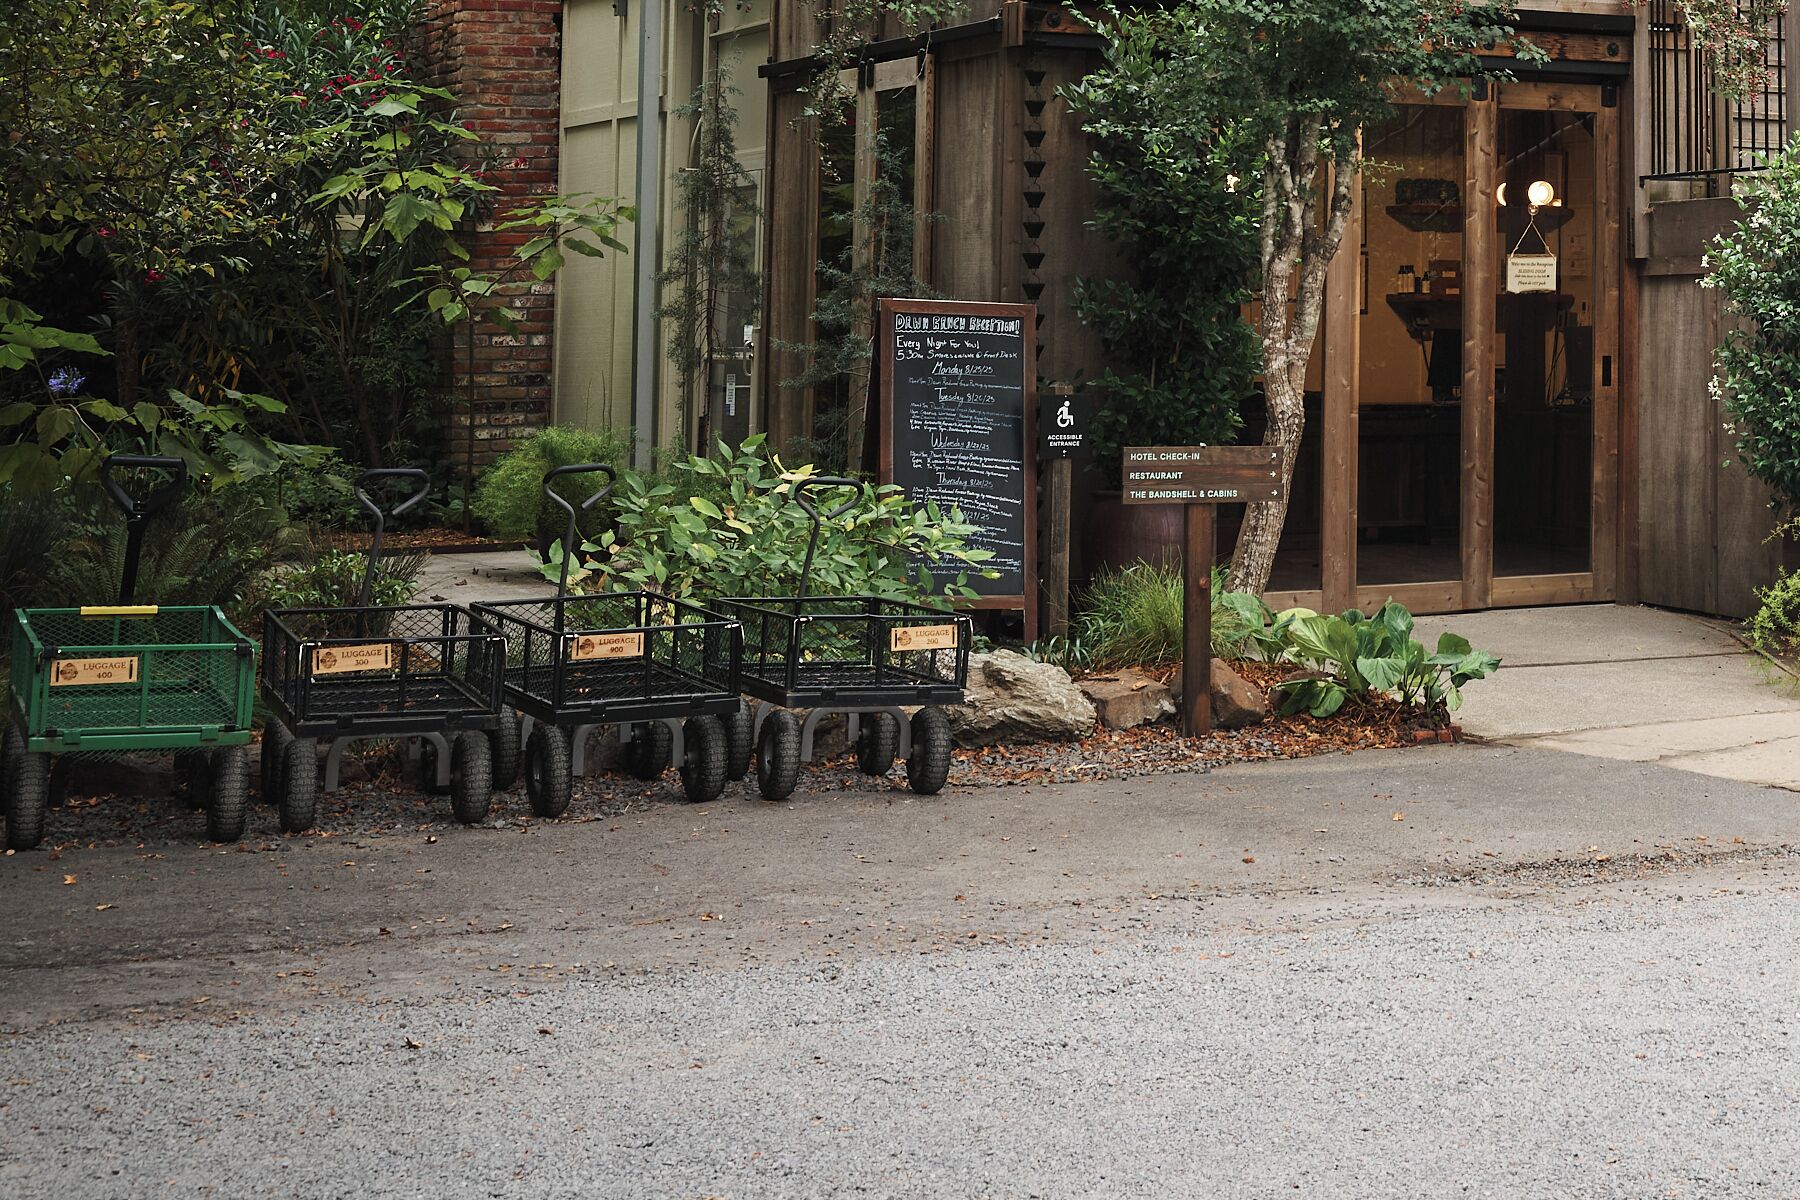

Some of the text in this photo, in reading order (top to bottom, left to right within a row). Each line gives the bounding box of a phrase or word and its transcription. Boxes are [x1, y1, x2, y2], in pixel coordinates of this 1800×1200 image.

[896, 314, 1020, 334] DAWN RANCH RECEPTION!
[896, 335, 920, 350] Every
[927, 336, 947, 349] Night
[950, 339, 960, 348] For
[932, 361, 963, 378] Monday
[934, 387, 964, 404] Tuesday
[1130, 452, 1200, 461] HOTEL CHECK-IN
[936, 472, 968, 488] Thursday
[1130, 472, 1183, 480] RESTAURANT
[1130, 490, 1238, 499] THE BANDSHELL & CABINS
[914, 629, 950, 638] LUGGAGE
[598, 638, 636, 646] LUGGAGE
[341, 648, 382, 659] LUGGAGE
[83, 661, 127, 671] LUGGAGE
[96, 671, 113, 680] 400
